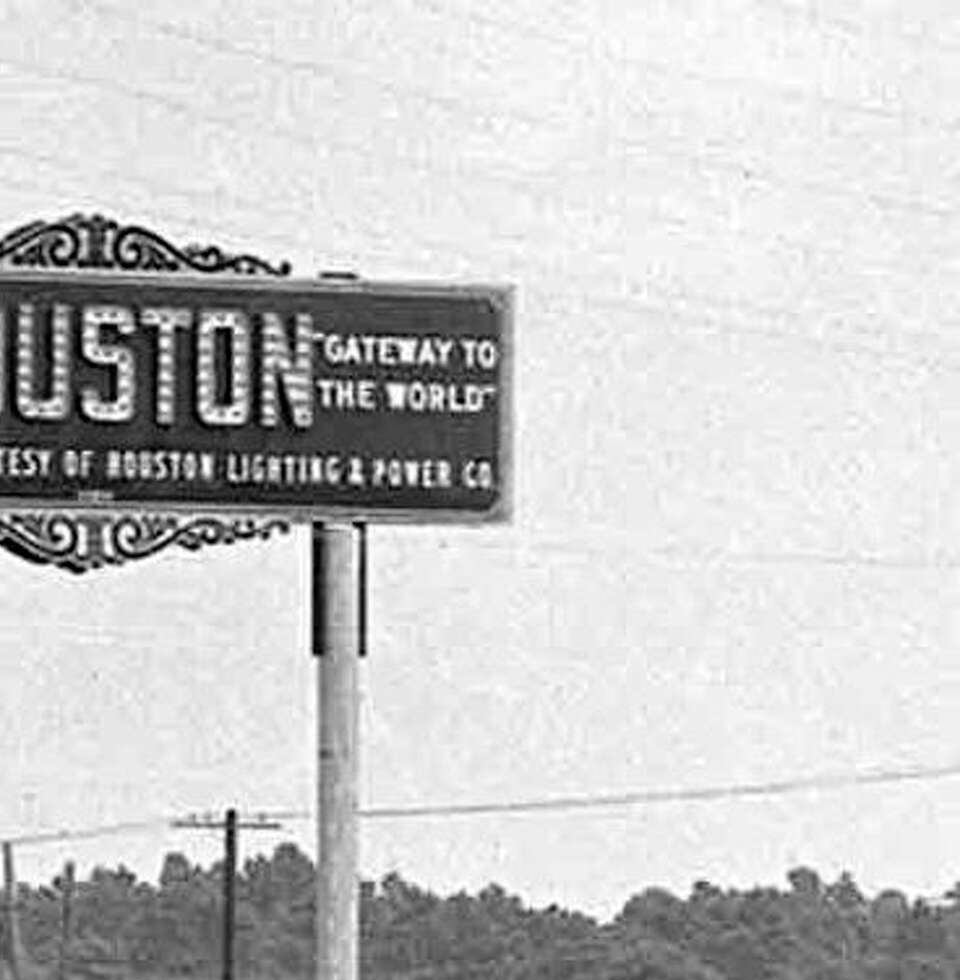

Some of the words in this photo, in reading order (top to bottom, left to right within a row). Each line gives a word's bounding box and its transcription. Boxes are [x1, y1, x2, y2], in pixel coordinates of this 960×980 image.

[461, 339, 496, 370] TO
[317, 379, 376, 410] THE
[63, 450, 94, 478] OF
[107, 450, 215, 481] HOUSTON
[227, 453, 342, 484] LIGHTING
[373, 457, 452, 487] POWER
